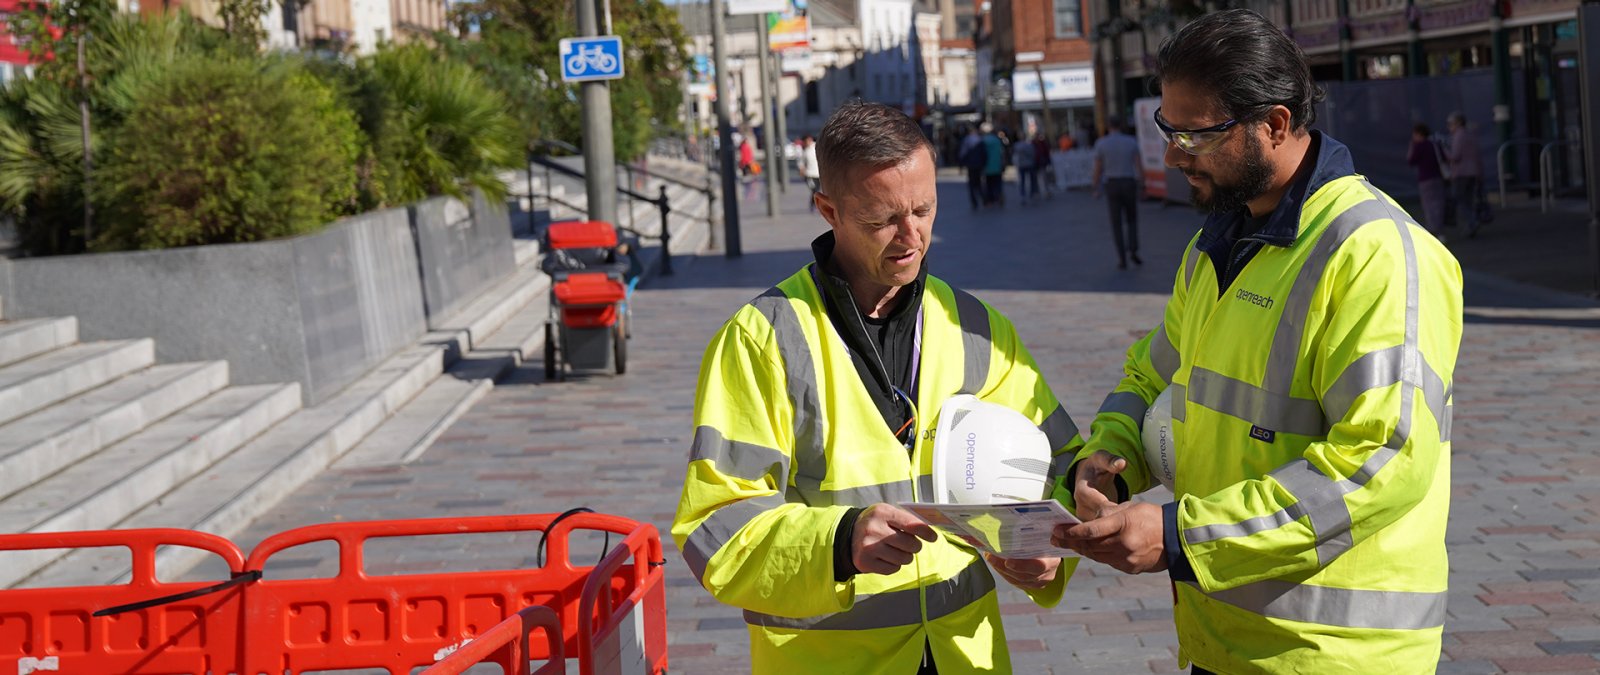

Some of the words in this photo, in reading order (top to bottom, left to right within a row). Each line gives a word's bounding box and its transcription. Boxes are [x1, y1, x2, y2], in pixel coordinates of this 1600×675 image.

[1236, 288, 1274, 310] openreach
[1252, 427, 1270, 439] LEO
[965, 432, 977, 490] openreach
[1160, 425, 1172, 480] openreach
